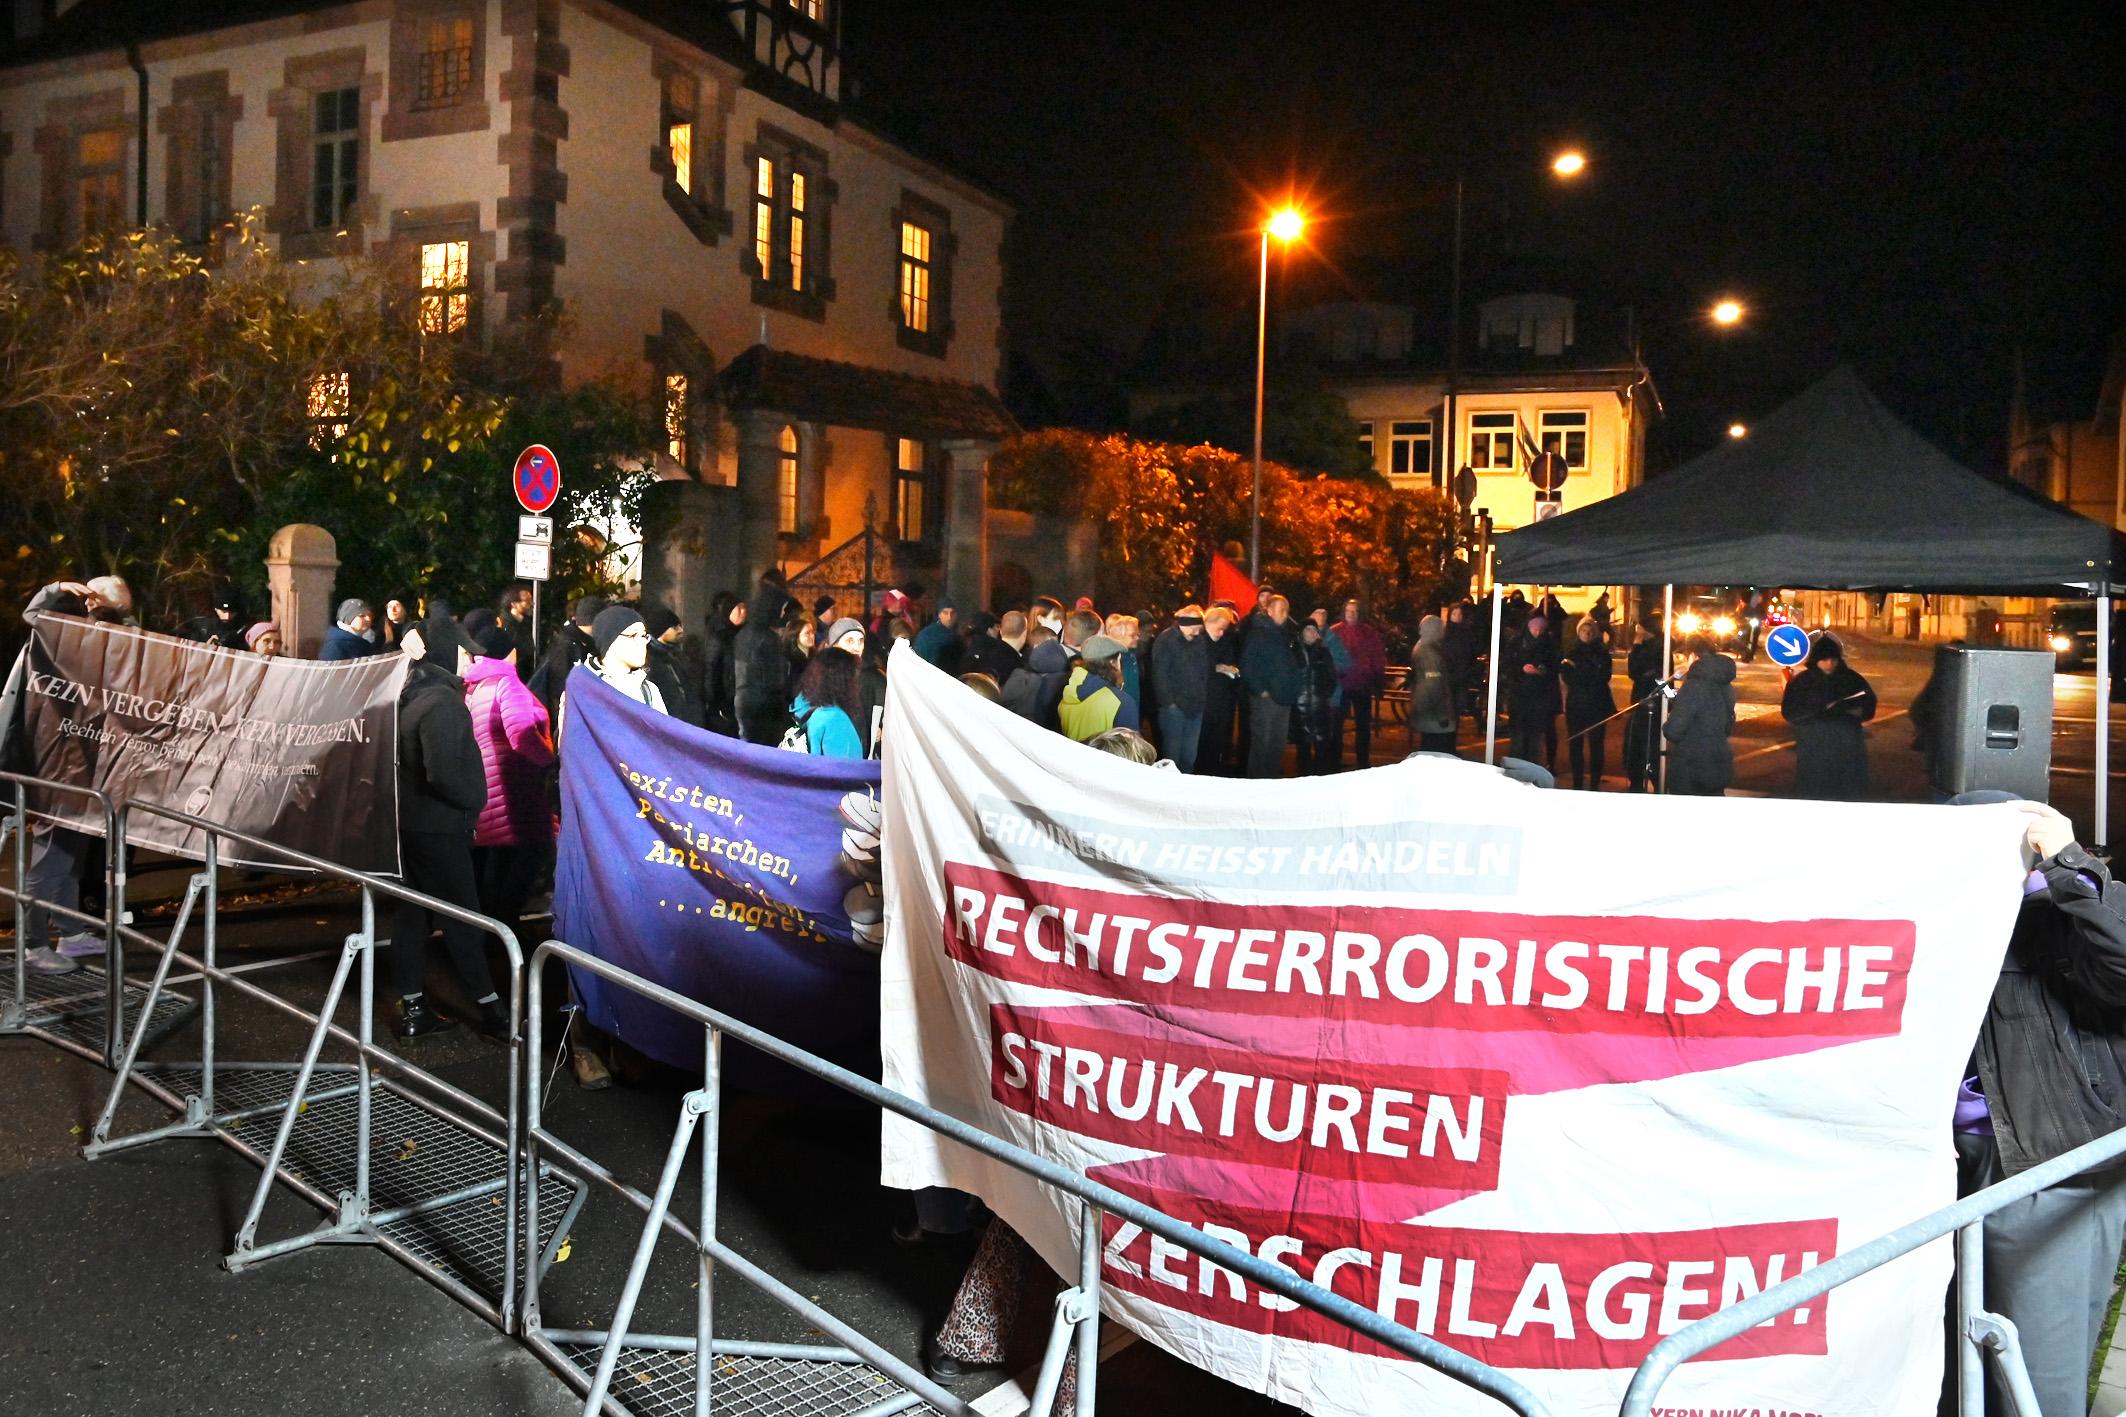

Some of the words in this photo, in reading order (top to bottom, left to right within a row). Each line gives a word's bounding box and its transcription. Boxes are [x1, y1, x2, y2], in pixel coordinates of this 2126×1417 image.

[26, 671, 95, 707] KEIN
[102, 689, 226, 735] VERGEBEN.
[231, 718, 285, 744] KEIN
[58, 718, 116, 744] Rechten
[122, 733, 158, 754] Terror
[979, 811, 1150, 865] ERINNERN
[1154, 843, 1293, 875] HEISST
[1299, 840, 1513, 876] HANDELN
[954, 886, 1894, 1016] RECHTSTERRORISTISCHE
[999, 1031, 1484, 1163] STRUKTUREN
[1104, 1210, 1819, 1340] ZERSCHLAGEN!
